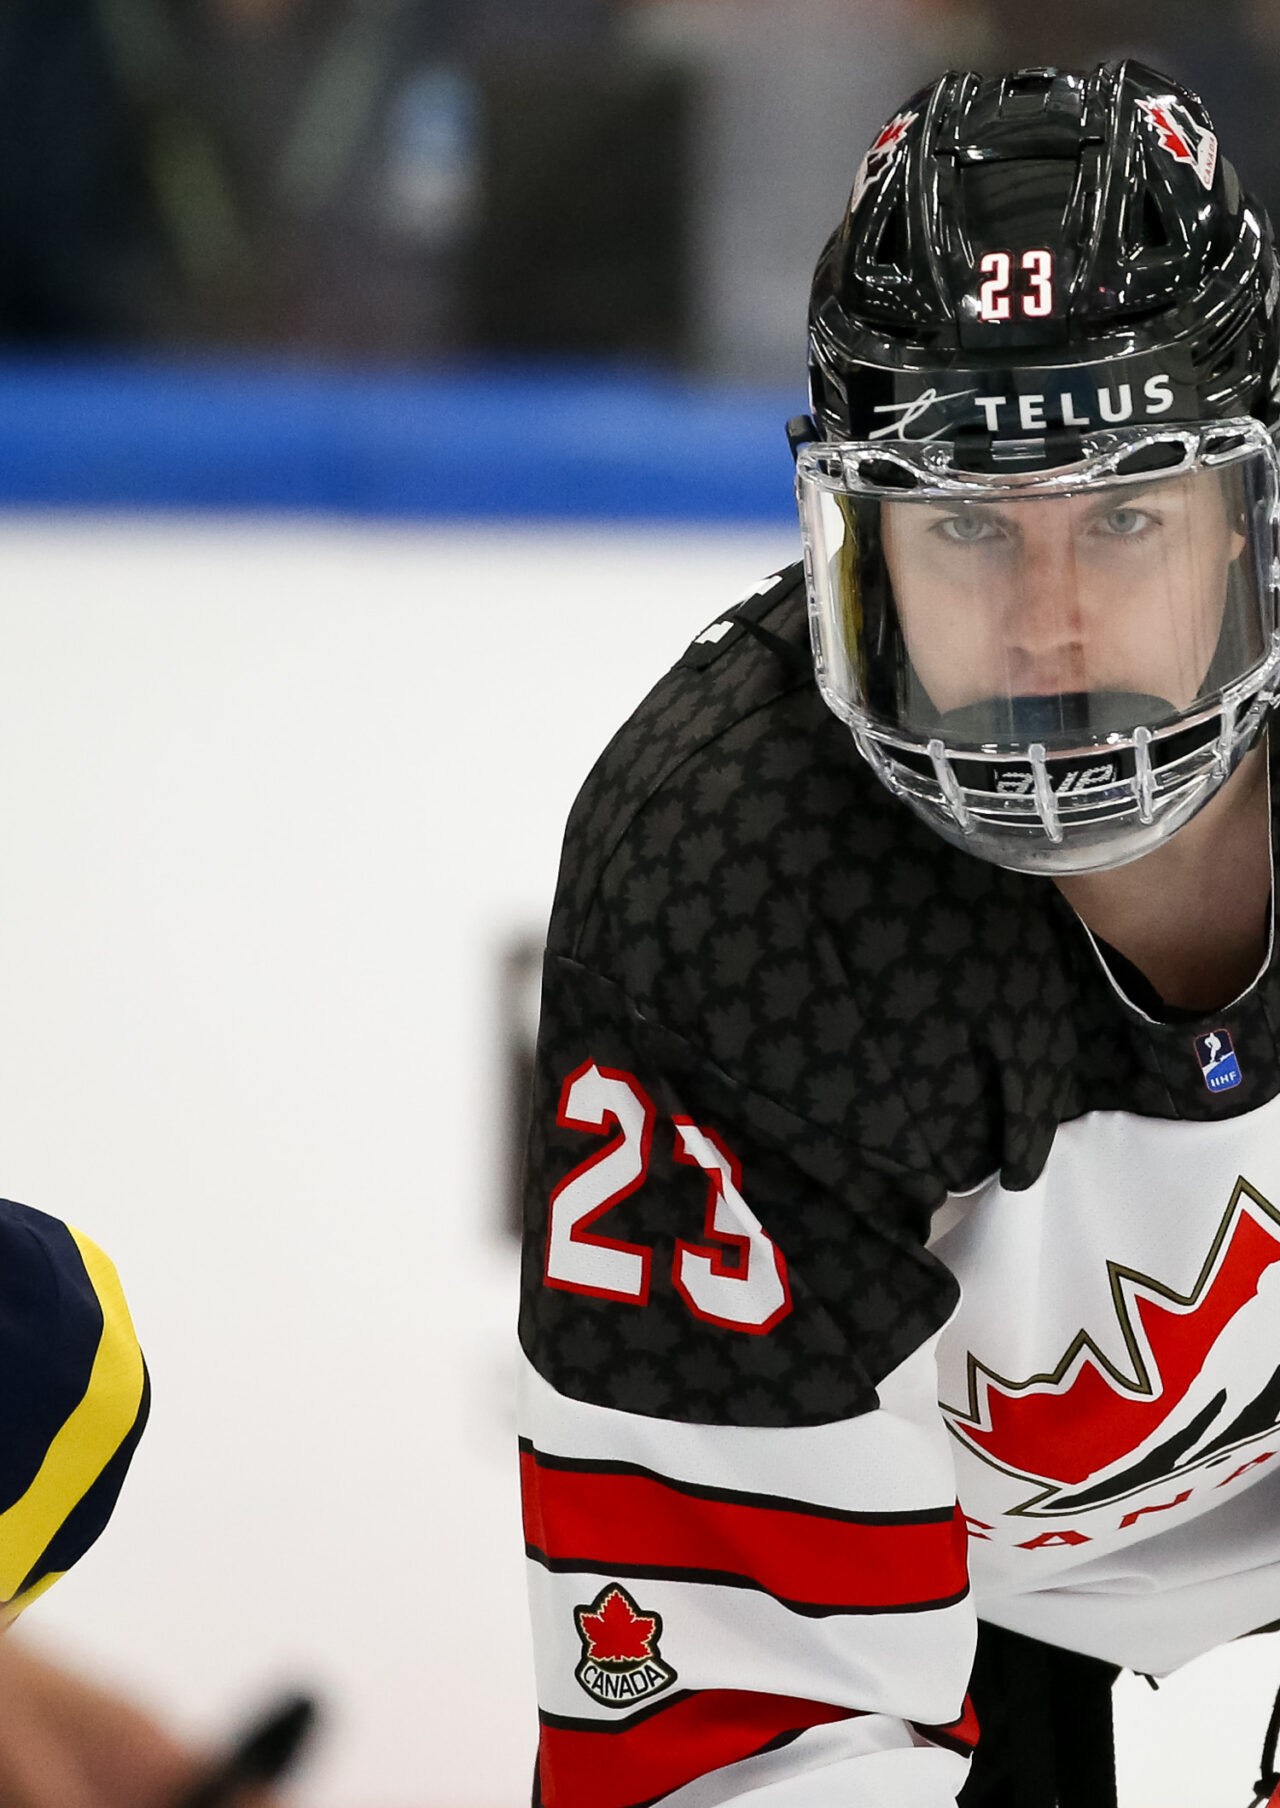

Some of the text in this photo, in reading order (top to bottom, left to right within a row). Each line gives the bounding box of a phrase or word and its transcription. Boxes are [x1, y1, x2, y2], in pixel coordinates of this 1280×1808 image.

[979, 249, 1053, 323] 23
[974, 373, 1175, 433] TELUS
[1210, 1071, 1237, 1088] IIHF
[543, 1057, 794, 1336] 23
[583, 1664, 666, 1699] CANADA
